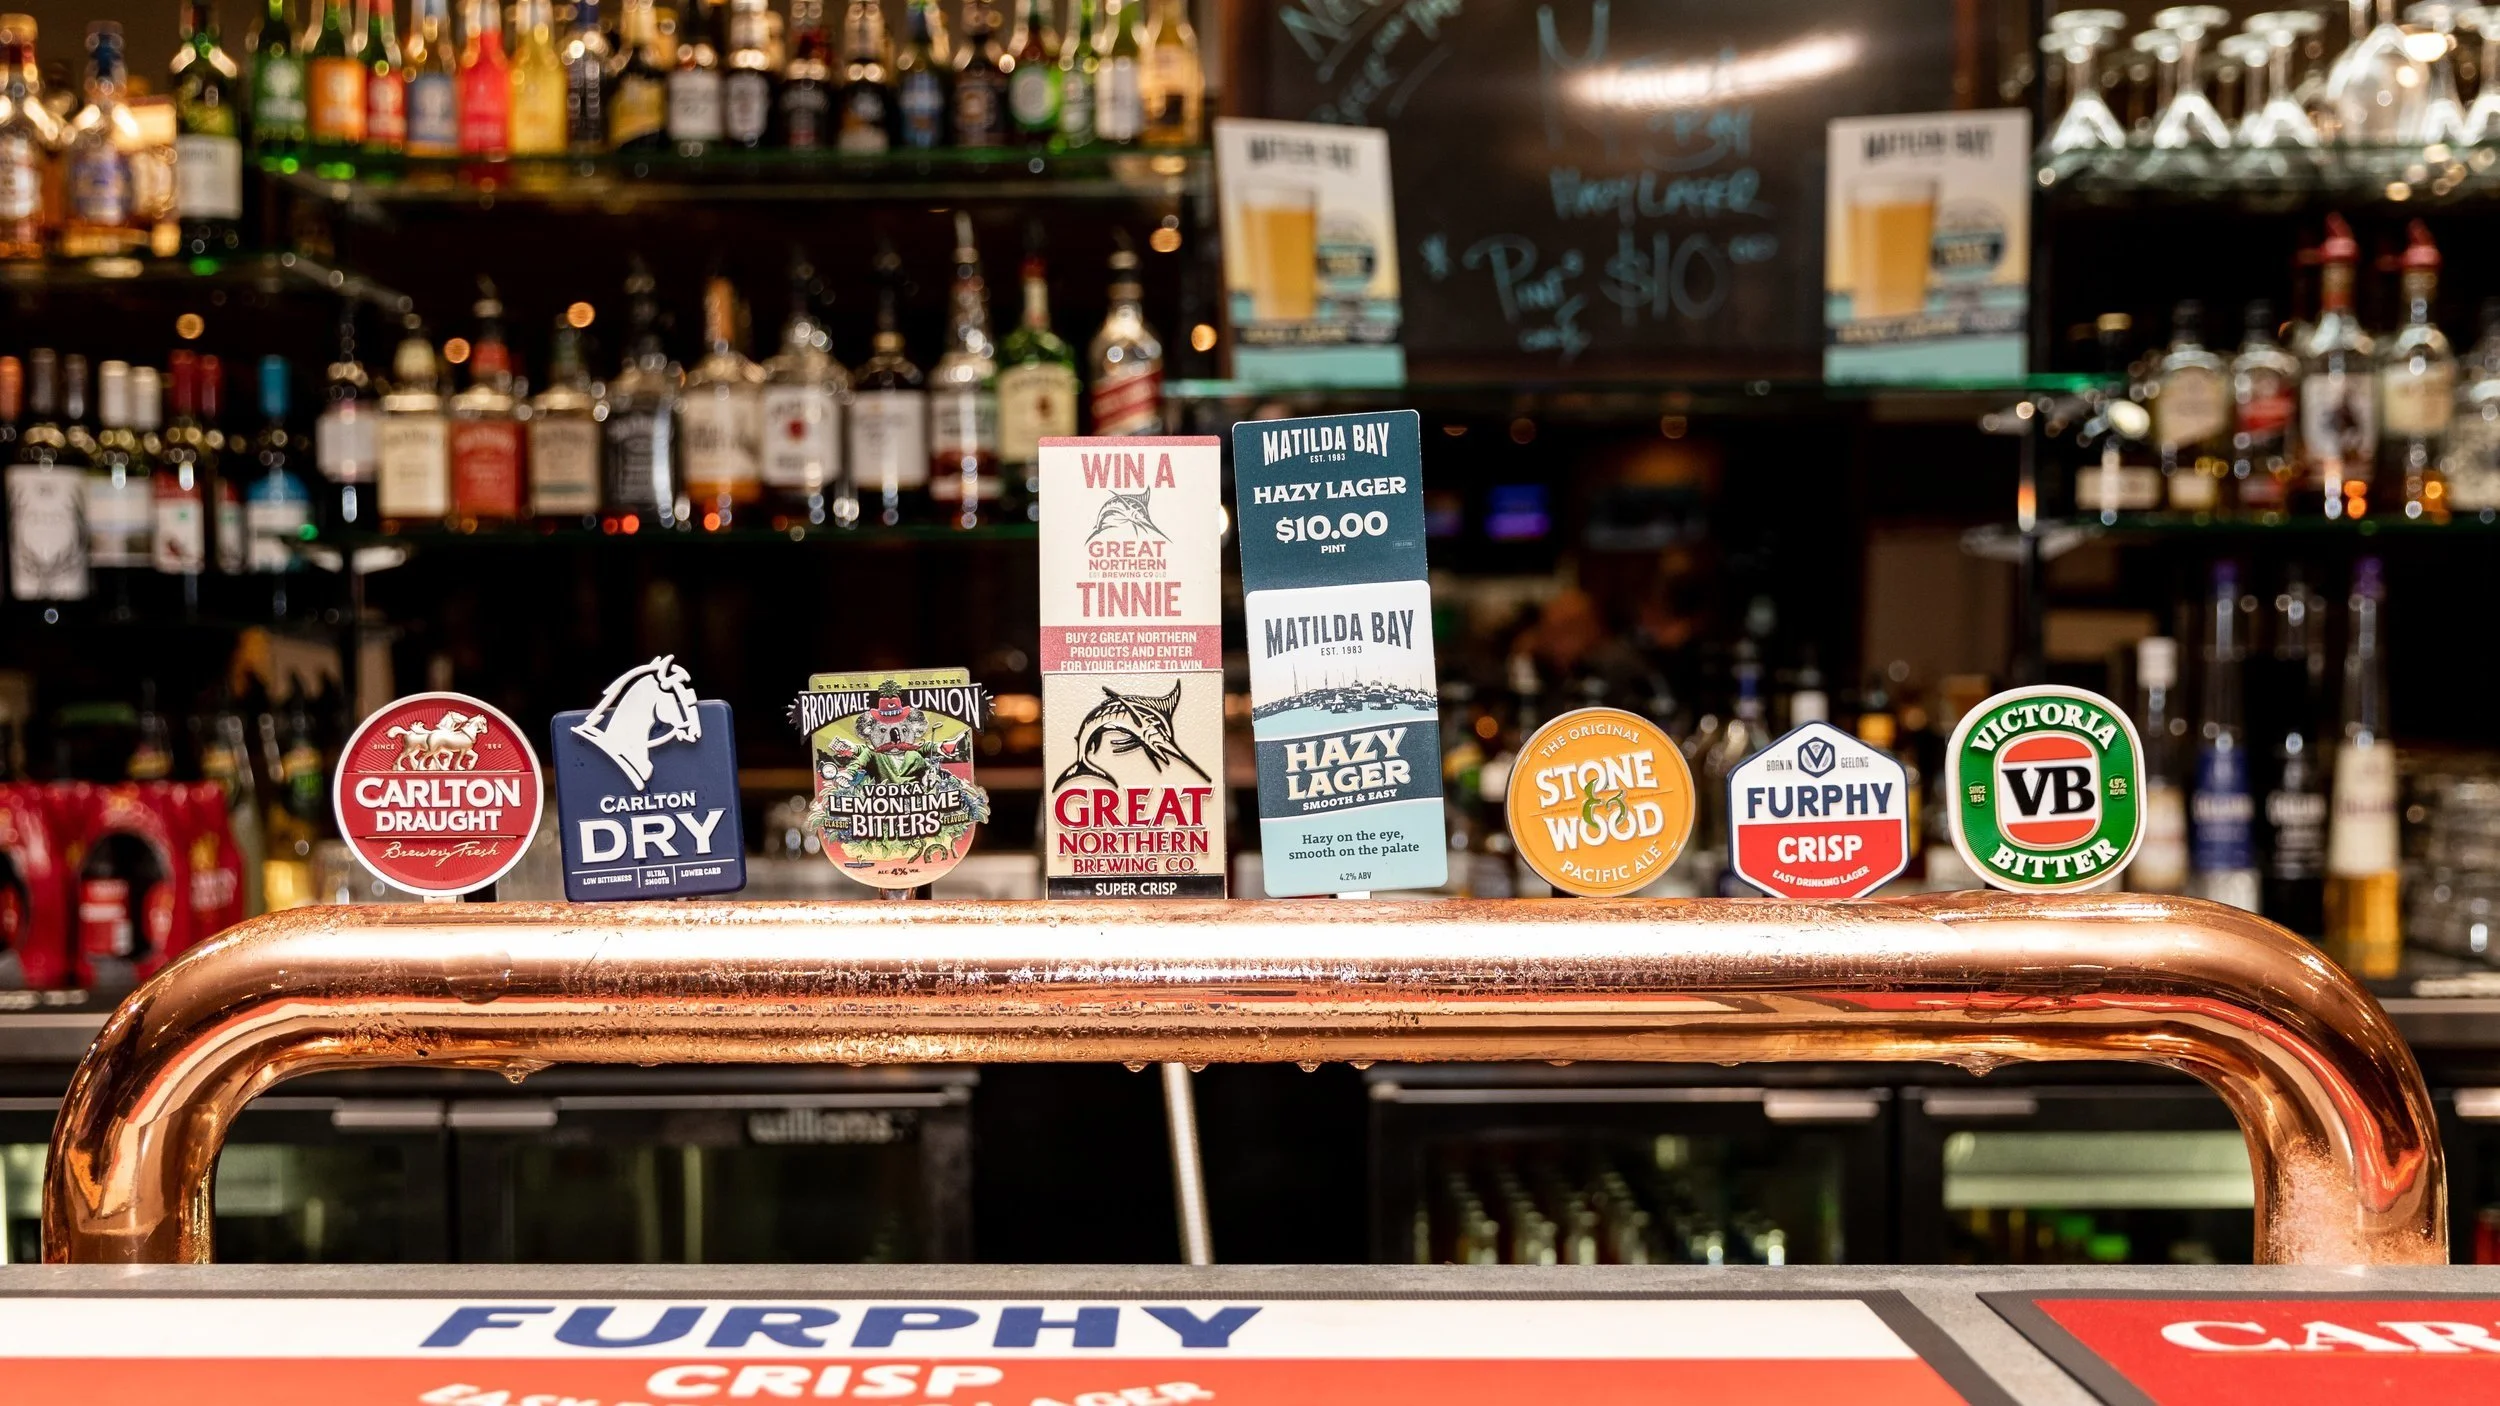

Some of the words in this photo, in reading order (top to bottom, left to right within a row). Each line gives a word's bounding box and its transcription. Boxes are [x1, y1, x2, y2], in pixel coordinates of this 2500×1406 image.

[1262, 425, 1347, 466] MATILDA
[1353, 422, 1390, 457] BAY
[1310, 454, 1326, 463] EST.
[1328, 453, 1346, 462] 1983
[1081, 453, 1145, 489] WIN
[1155, 453, 1176, 489] A
[1253, 482, 1321, 505] HAZY
[1326, 476, 1407, 500] LAGER
[1275, 510, 1389, 544] $10.00
[1088, 540, 1167, 558] GREAT
[1320, 543, 1347, 554] PINT
[1088, 559, 1167, 571] NORTHERN
[1102, 571, 1141, 579] BREWING
[1076, 581, 1182, 618] TINNIE
[1065, 632, 1088, 644] BUY
[1090, 632, 1097, 643] 2
[1100, 632, 1135, 643] GREAT
[1137, 631, 1197, 643] NORTHERN
[1264, 612, 1364, 659] MATILDA
[1371, 609, 1414, 650] BAY
[1070, 646, 1130, 658] PRODUCTS
[1131, 646, 1155, 657] AND
[1157, 645, 1193, 657] ENTER
[1320, 647, 1339, 656] EST.
[1342, 645, 1363, 655] 1983
[1060, 660, 1082, 671] FOR
[1084, 660, 1115, 671] YOUR
[1116, 660, 1161, 671] CHANCE
[1163, 660, 1178, 670] TO
[1180, 660, 1203, 670] WIN
[802, 691, 871, 737] BROOKVALE
[909, 687, 982, 730] UNION
[1970, 703, 2117, 753] VICTORIA
[373, 743, 396, 751] SINCE
[1283, 726, 1408, 774] HAZY
[1541, 735, 1568, 759] THE
[1569, 723, 1640, 745] ORIGINAL
[1766, 760, 1785, 772] BORN
[1786, 759, 1793, 771] IN
[1840, 756, 1869, 769] GEELONG
[863, 783, 924, 798] VODKA
[1285, 759, 1411, 801] LAGER
[1535, 748, 1659, 809] STONE
[355, 777, 522, 809] CARLTON
[600, 791, 698, 814] CARLTON
[829, 795, 906, 814] LEMON
[910, 790, 961, 812] LIME
[1302, 794, 1354, 811] SMOOTH
[1356, 793, 1365, 803] &
[1368, 788, 1398, 801] EASY
[1747, 782, 1893, 819] FURPHY
[2001, 765, 2096, 817] VB
[943, 813, 969, 825] FLAVOUR
[1054, 787, 1213, 829] GREAT
[376, 810, 502, 832] DRAUGHT
[824, 819, 850, 829] CLASSIC
[852, 810, 942, 838] BITTERS
[1543, 801, 1664, 852] WOOD
[578, 808, 727, 865] DRY
[1058, 830, 1209, 855] NORTHERN
[1302, 833, 1334, 846] Hazy
[1337, 833, 1353, 843] on
[1355, 830, 1376, 841] the
[1379, 829, 1405, 842] eye,
[381, 840, 455, 868] Brewery
[452, 840, 501, 859] Fresh
[1288, 848, 1336, 860] smooth
[1339, 848, 1355, 857] on
[1358, 845, 1378, 856] the
[1381, 842, 1420, 857] palate
[1634, 843, 1663, 874] ALE
[1777, 834, 1863, 864] CRISP
[1988, 837, 2120, 879] BITTER
[646, 869, 667, 878] ULTRA
[680, 868, 703, 878] LOWER
[704, 866, 722, 876] CARB
[890, 867, 908, 876] 4%
[1073, 857, 1158, 874] BREWING
[1165, 856, 1198, 873] CO.
[1339, 872, 1357, 882] 4.2%
[1358, 871, 1372, 881] ABV
[1560, 859, 1630, 883] PACIFIC
[1771, 869, 1796, 885] EASY
[1796, 877, 1840, 888] DRINKING
[1840, 865, 1871, 885] LAGER
[583, 876, 597, 886] LOW
[597, 874, 633, 885] BITTERNESS
[645, 877, 670, 886] SMOOTH
[1095, 882, 1137, 896] SUPER
[1140, 882, 1178, 896] CRISP
[418, 1306, 1264, 1348] FURPHY
[2160, 1320, 2500, 1353] CAR
[646, 1364, 1004, 1398] CRISP
